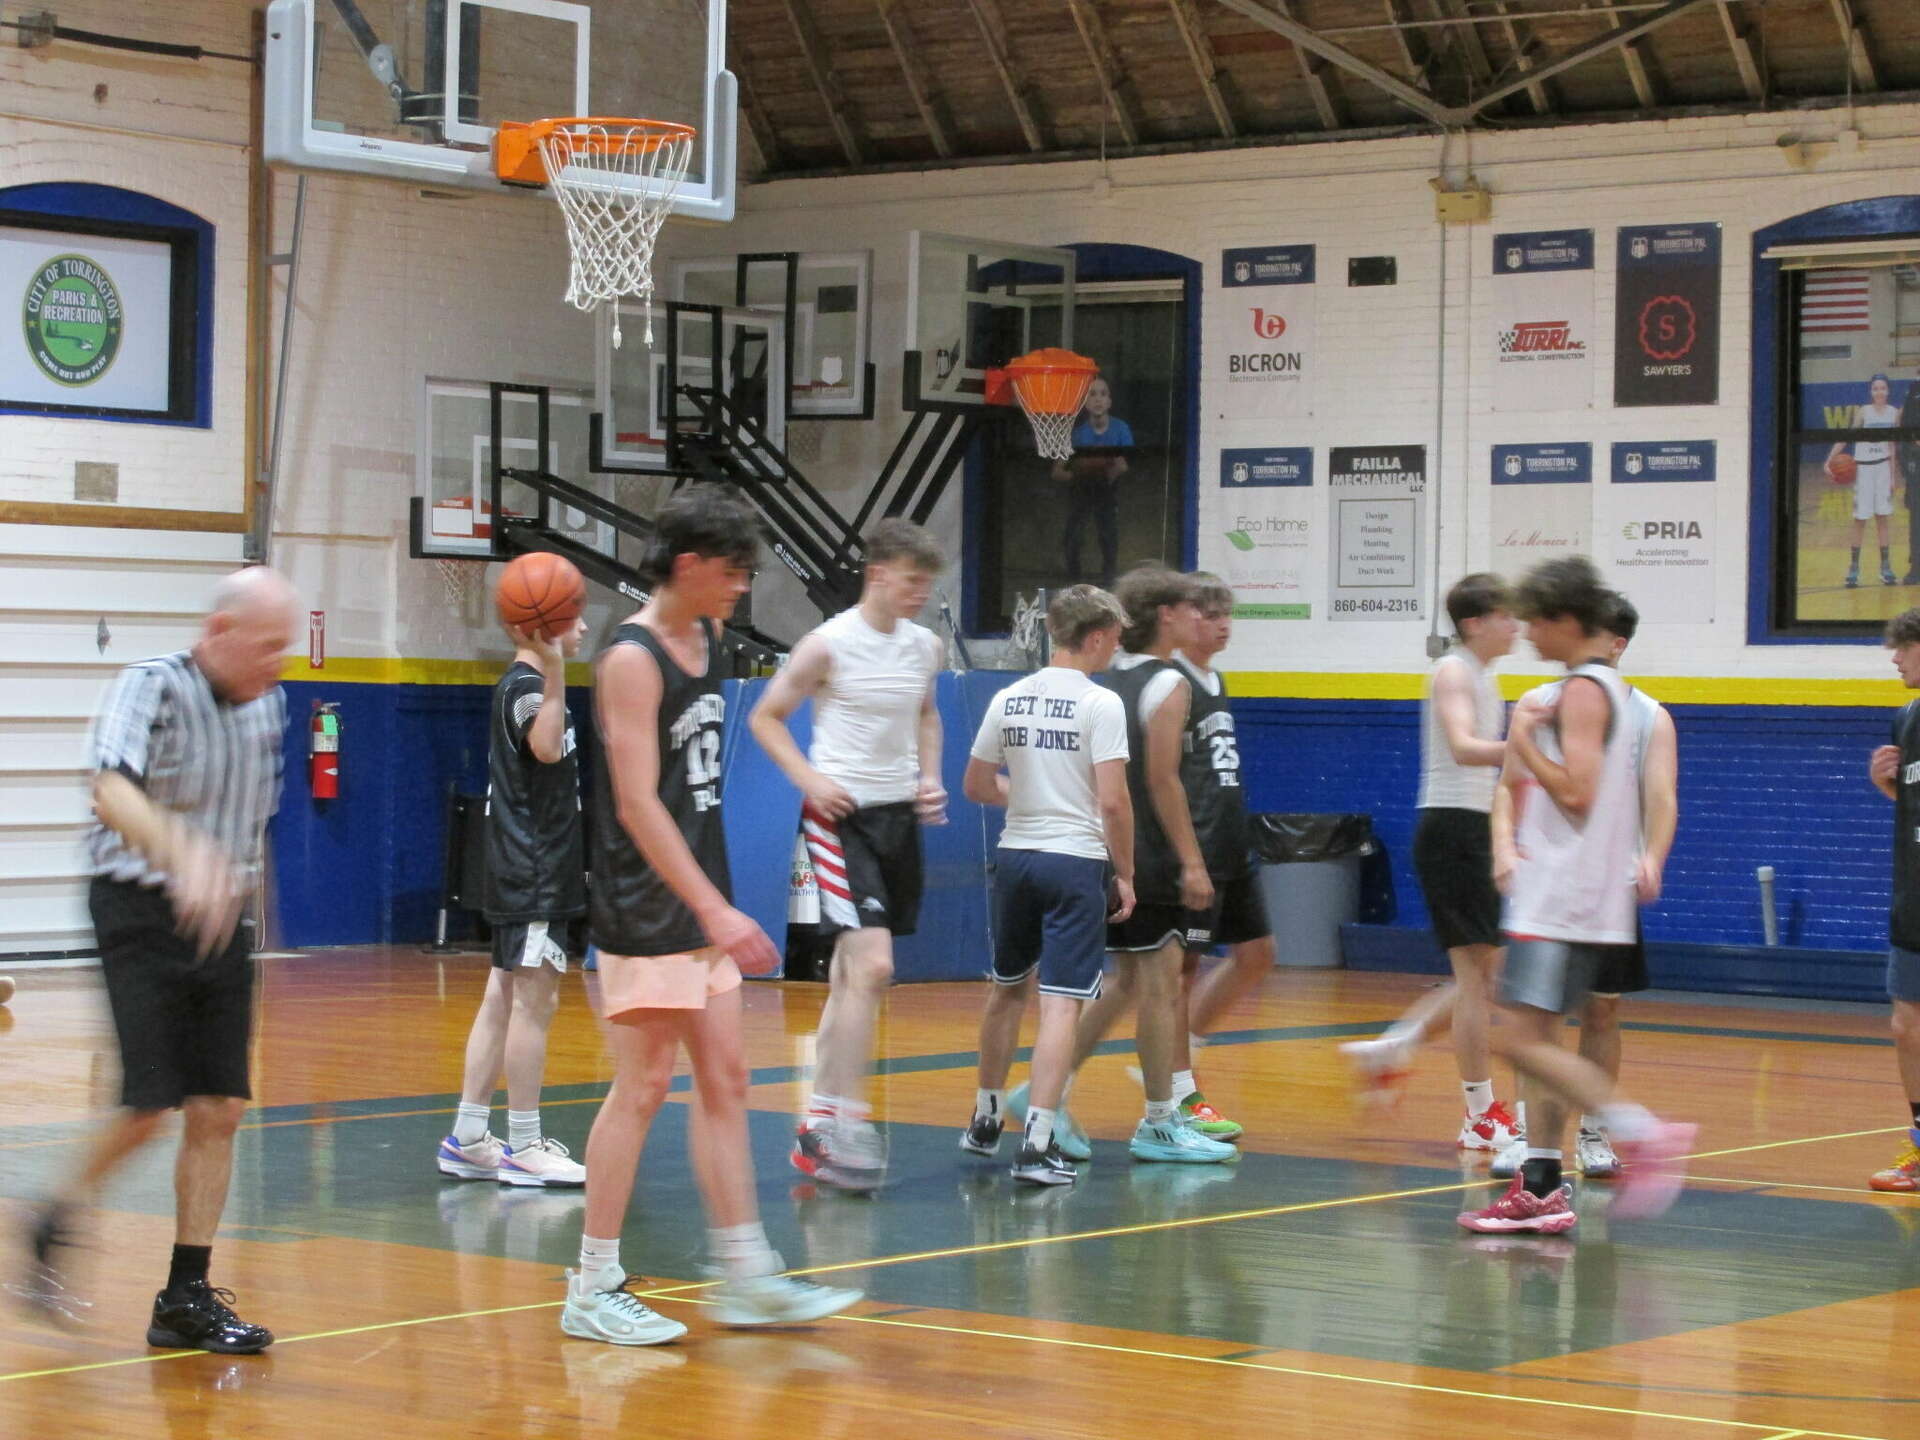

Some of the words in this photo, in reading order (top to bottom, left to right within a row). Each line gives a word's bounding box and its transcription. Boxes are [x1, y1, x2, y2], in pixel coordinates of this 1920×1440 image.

[28, 278, 47, 312] CITY
[45, 263, 59, 283] OF
[63, 260, 121, 319] TORRINGTON
[52, 290, 86, 306] PARKS
[91, 294, 98, 307] &
[44, 304, 104, 324] RECREATION
[1659, 315, 1675, 340] S
[1229, 353, 1301, 373] BICRON
[1352, 457, 1402, 471] FAILLA
[1332, 472, 1424, 486] MECHANICAL
[1236, 516, 1262, 532] Eco
[1266, 517, 1309, 532] Home
[1644, 521, 1703, 540] PRIA
[1616, 558, 1662, 566] Healthcare
[1334, 600, 1418, 613] 860-604-2316
[1004, 696, 1038, 716] GET
[1044, 698, 1077, 719] THE
[1002, 727, 1028, 748] JOB
[1034, 729, 1081, 752] DONE
[1210, 736, 1240, 770] 25
